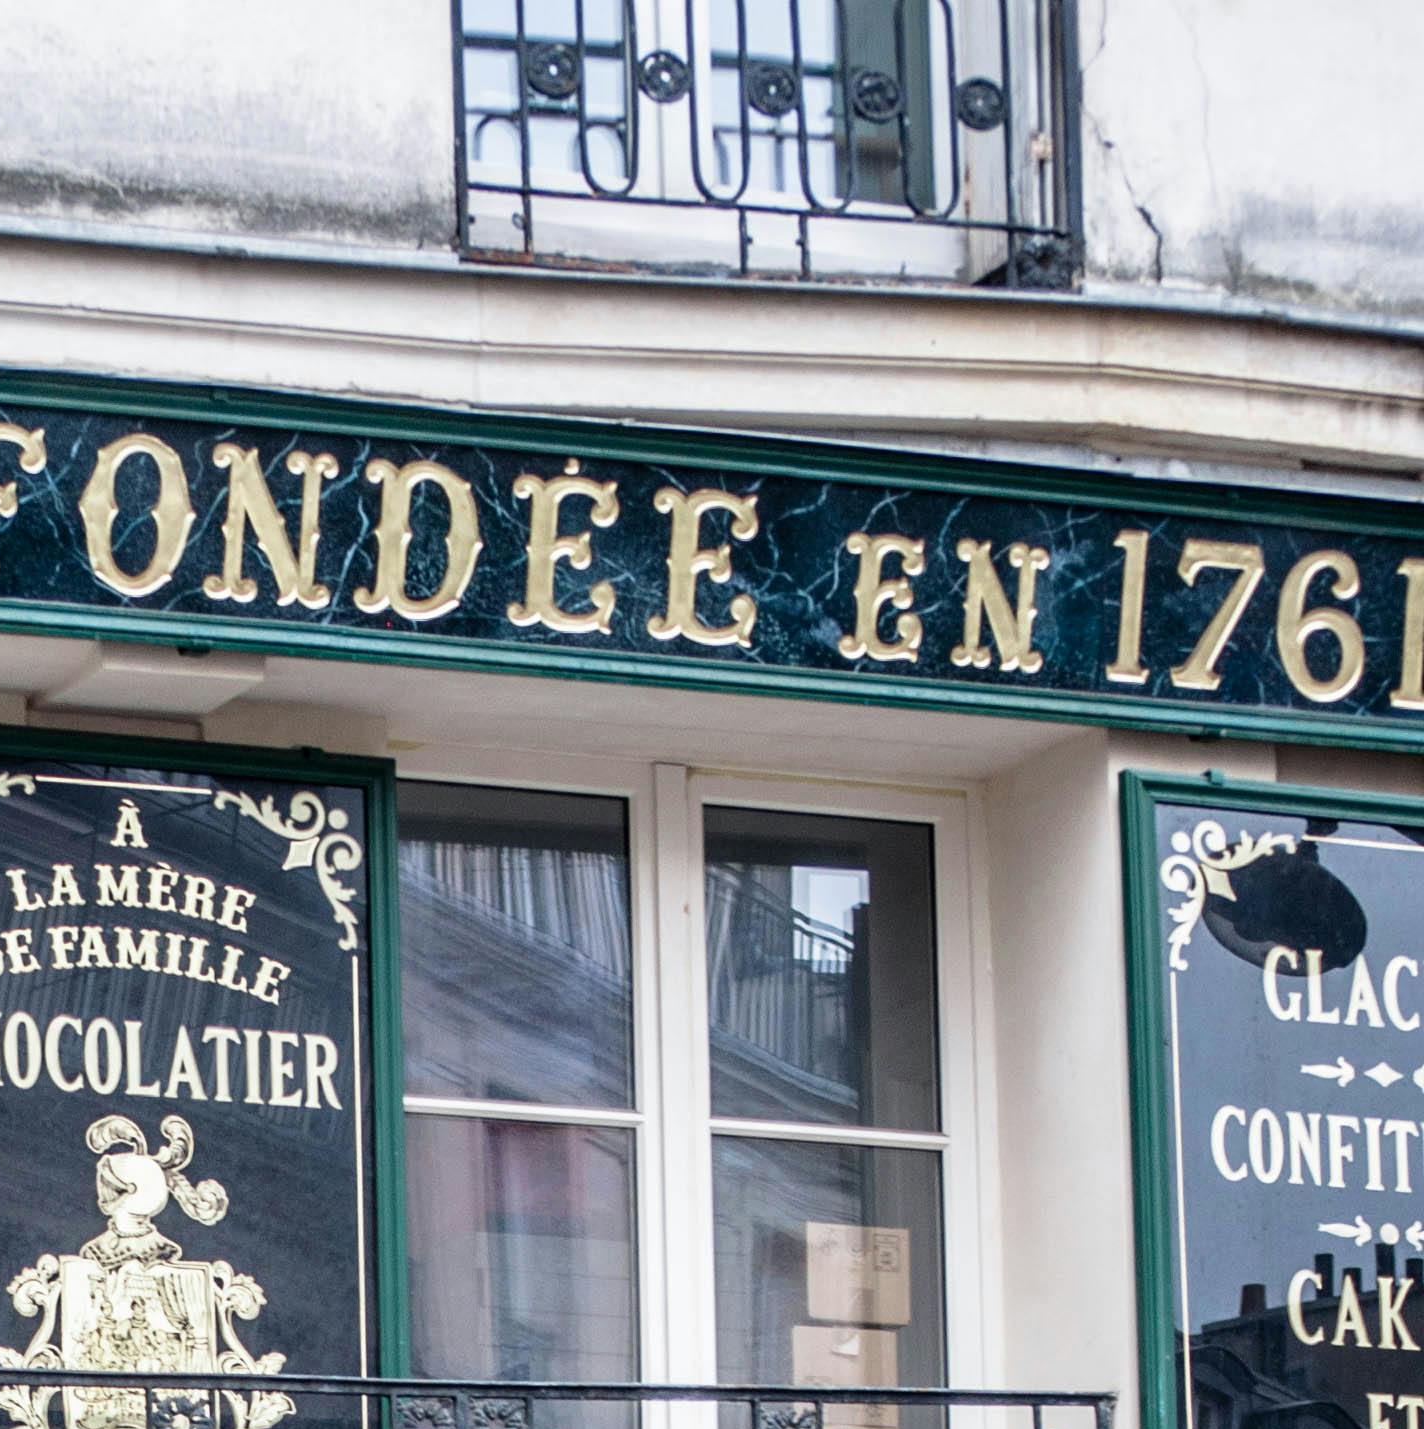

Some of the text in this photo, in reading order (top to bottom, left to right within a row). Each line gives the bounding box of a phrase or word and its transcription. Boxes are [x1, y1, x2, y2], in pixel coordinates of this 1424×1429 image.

[839, 531, 1051, 673] EN
[1105, 529, 1424, 711] 1761
[111, 798, 148, 849] À
[5, 861, 257, 934] LA MÈRE
[46, 925, 291, 1006] FAMILLE
[1210, 1104, 1424, 1194] CONFIT
